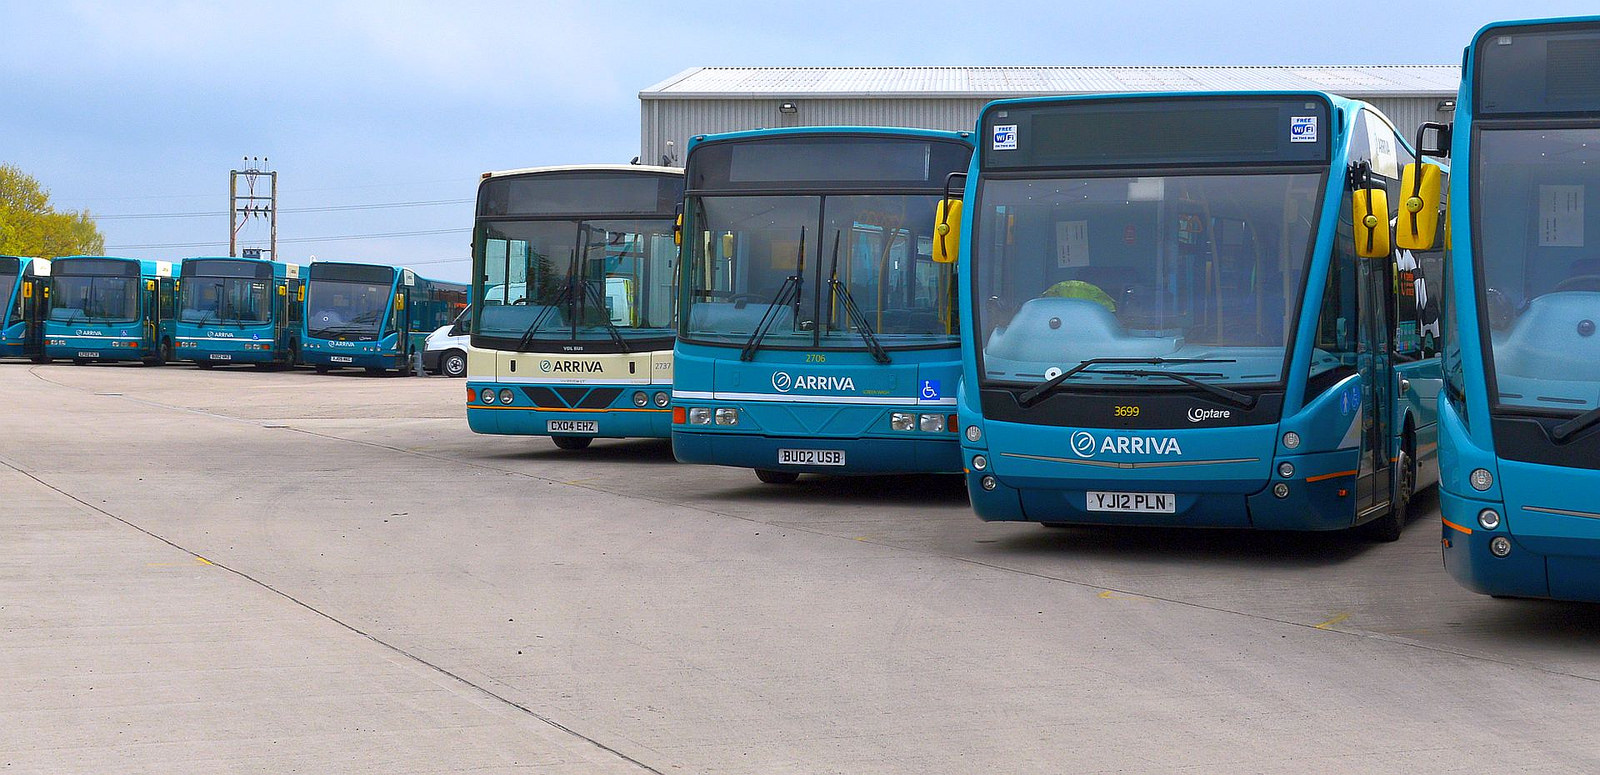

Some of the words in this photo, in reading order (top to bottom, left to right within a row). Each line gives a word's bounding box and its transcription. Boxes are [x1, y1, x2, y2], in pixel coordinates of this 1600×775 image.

[806, 354, 826, 362] 2706
[553, 360, 604, 373] ARRIVA
[655, 362, 671, 370] 2737
[794, 375, 855, 391] ARRIVA
[1114, 406, 1140, 417] 3699
[1194, 408, 1231, 421] Optare
[551, 421, 575, 431] CX04
[576, 421, 594, 431] EHZ
[1100, 436, 1182, 455] ARRIVA
[783, 450, 814, 463] BU02
[817, 451, 841, 464] USB
[1096, 494, 1130, 509] YJ12
[1135, 495, 1166, 510] PLN
